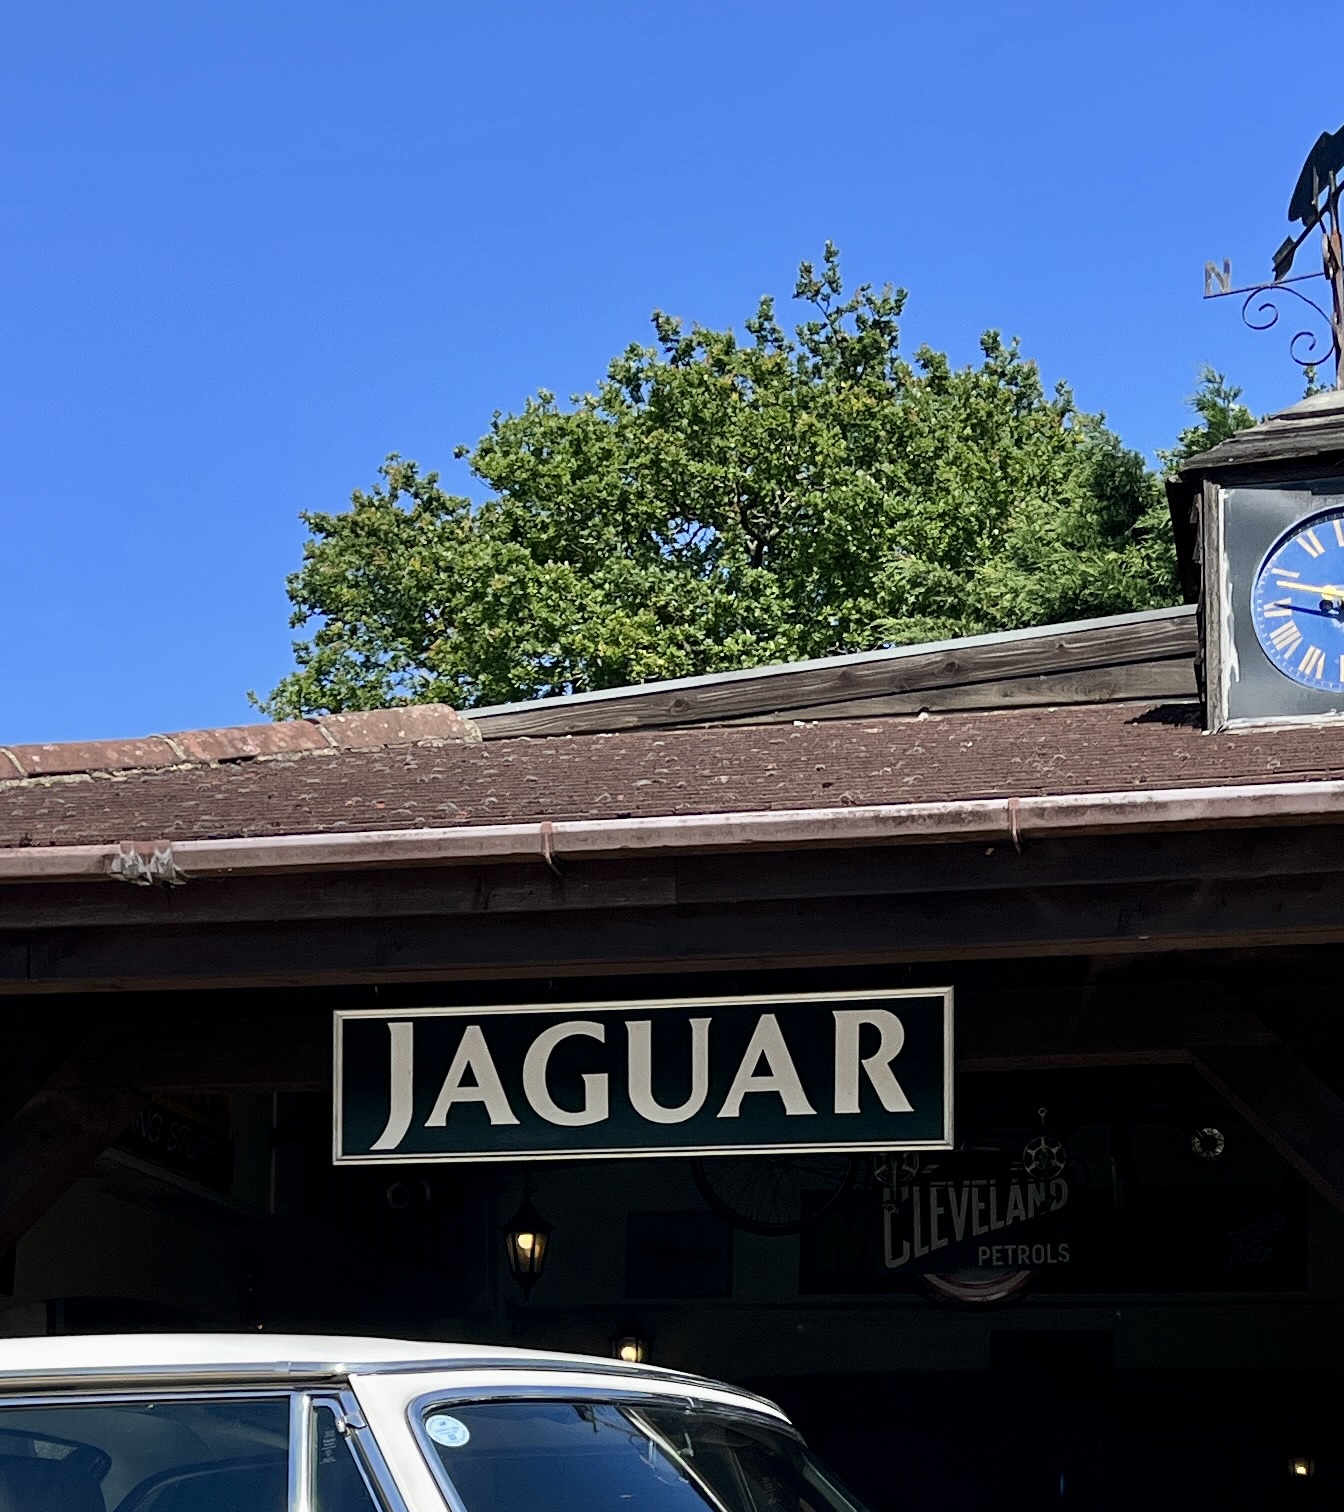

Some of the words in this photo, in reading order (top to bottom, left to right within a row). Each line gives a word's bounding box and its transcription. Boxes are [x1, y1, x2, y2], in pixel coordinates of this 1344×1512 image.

[1204, 257, 1232, 295] N
[369, 1009, 915, 1150] JAGUAR
[883, 1177, 1069, 1269] CLEVELAND
[978, 1243, 1071, 1266] PETROLS
